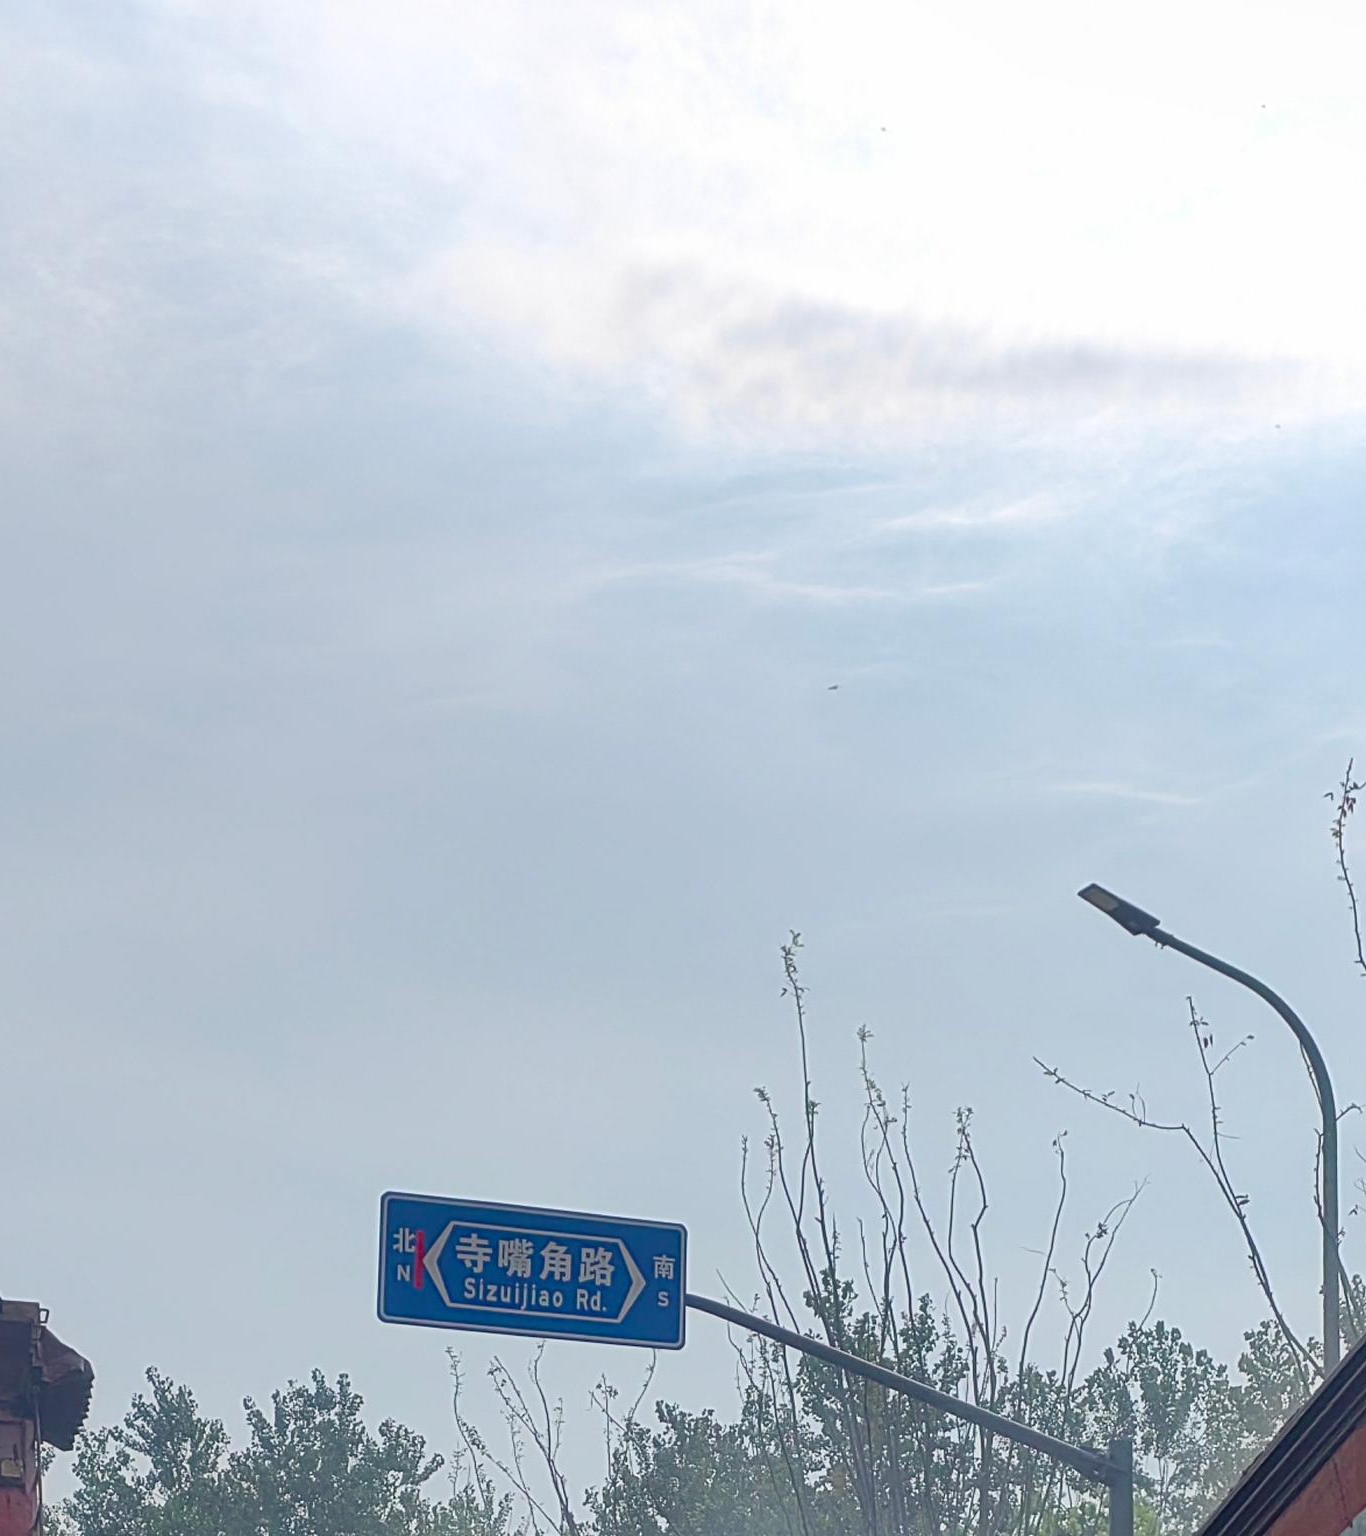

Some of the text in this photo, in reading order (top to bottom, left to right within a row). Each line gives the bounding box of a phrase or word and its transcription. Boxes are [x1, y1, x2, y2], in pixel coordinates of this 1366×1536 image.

[393, 1227, 417, 1253] 北
[396, 1264, 411, 1282] N
[455, 1232, 616, 1288] 寺嘴角路
[652, 1254, 675, 1280] 南
[463, 1277, 607, 1313] Sizuijiao Rd.
[657, 1291, 669, 1307] S
